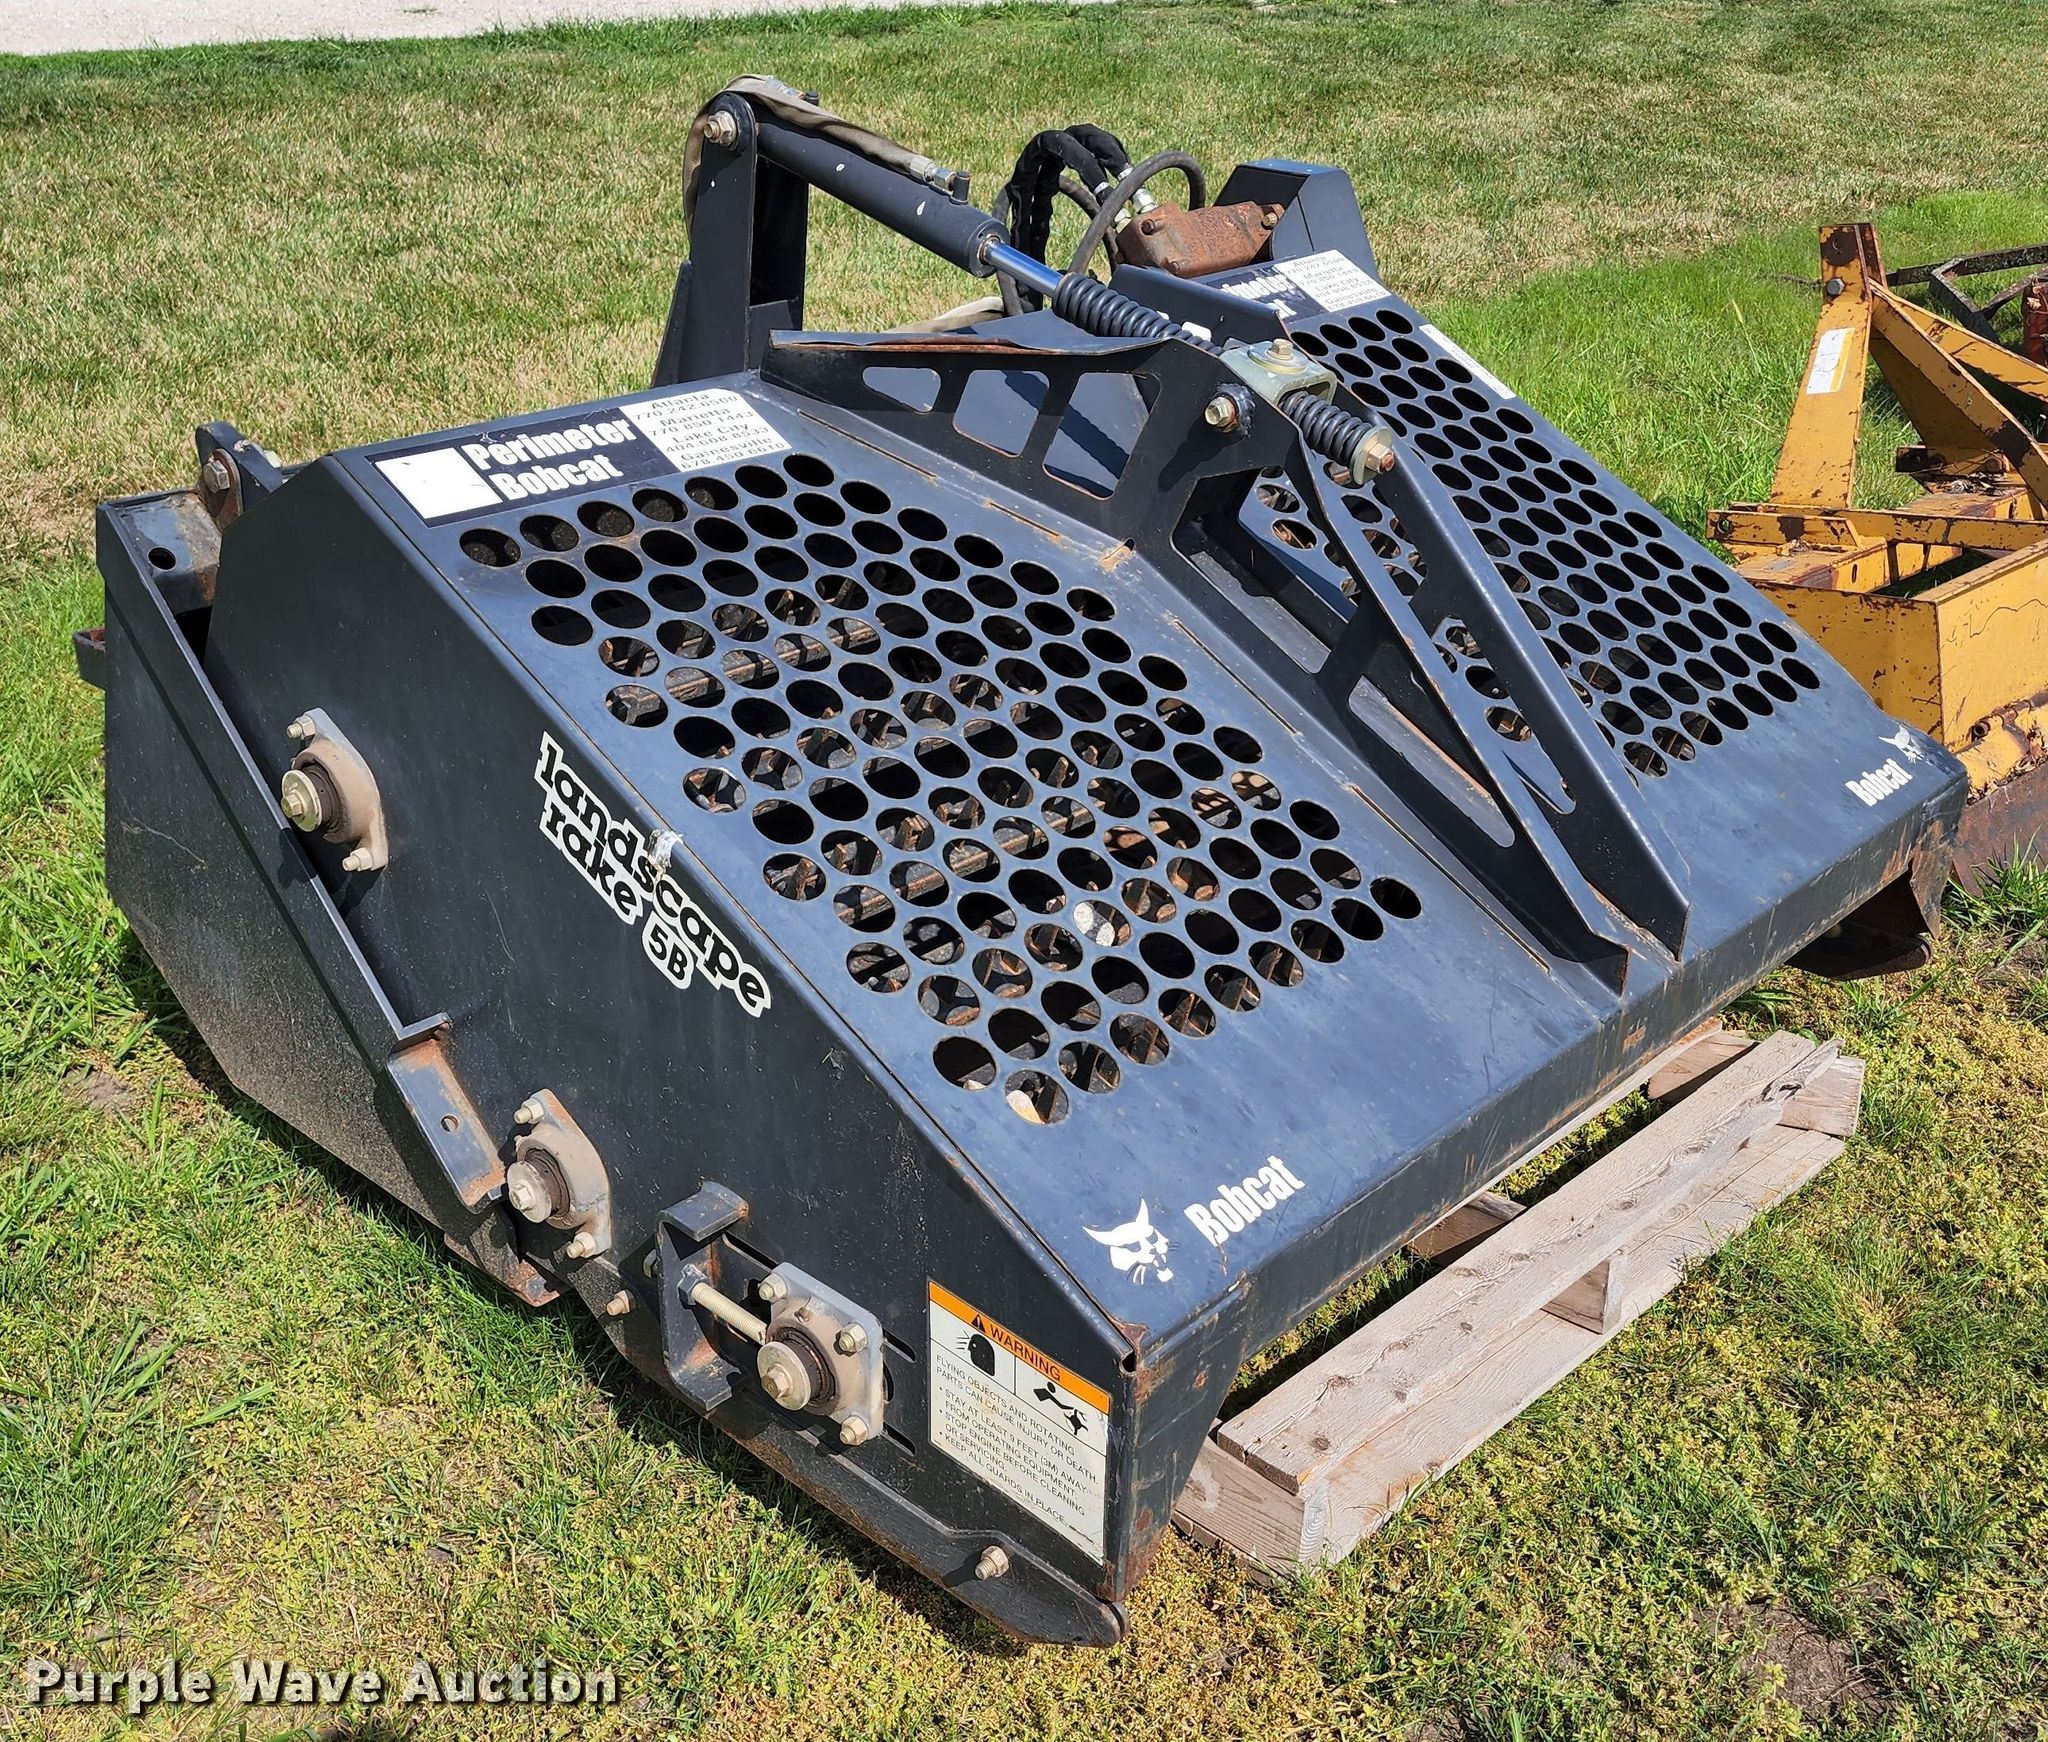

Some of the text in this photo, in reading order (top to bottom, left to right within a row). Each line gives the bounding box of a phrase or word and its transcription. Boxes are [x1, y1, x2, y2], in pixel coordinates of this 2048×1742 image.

[651, 393, 711, 410] Atlanta
[659, 408, 731, 427] Marietta
[461, 418, 638, 471] Perimeter
[672, 423, 750, 445] Lake City
[680, 438, 773, 462] Gainesville
[488, 454, 625, 501] Bobcat
[1844, 757, 1914, 807] Bobcat
[541, 740, 766, 1009] landscape
[545, 805, 689, 982] rake 5B
[1183, 1155, 1306, 1247] Bobcat
[989, 1323, 1062, 1382] WARNING
[936, 1354, 1075, 1456] FLYING OBJECTS AND ROTATING
[936, 1366, 964, 1390] PARTS
[965, 1386, 983, 1404] CAN
[985, 1400, 1015, 1426] CAUSE
[1016, 1420, 1049, 1448] INJURY
[1050, 1445, 1064, 1461] OR
[945, 1400, 970, 1422] FROM
[971, 1419, 1021, 1459] OPERATING
[945, 1423, 958, 1437] OR
[945, 1388, 966, 1407] STAY
[967, 1405, 979, 1418] AT
[980, 1413, 1008, 1437] LEAST
[1016, 1439, 1039, 1459] FEET
[1040, 1455, 1059, 1476] (3M)
[1060, 1471, 1087, 1493] AWAY
[945, 1411, 1085, 1516] STOP ENGINE BEFORE CLEANING
[945, 1433, 967, 1452] KEEP
[968, 1450, 983, 1467] ALL
[985, 1463, 1023, 1494] GUARDS
[1024, 1489, 1034, 1502] IN
